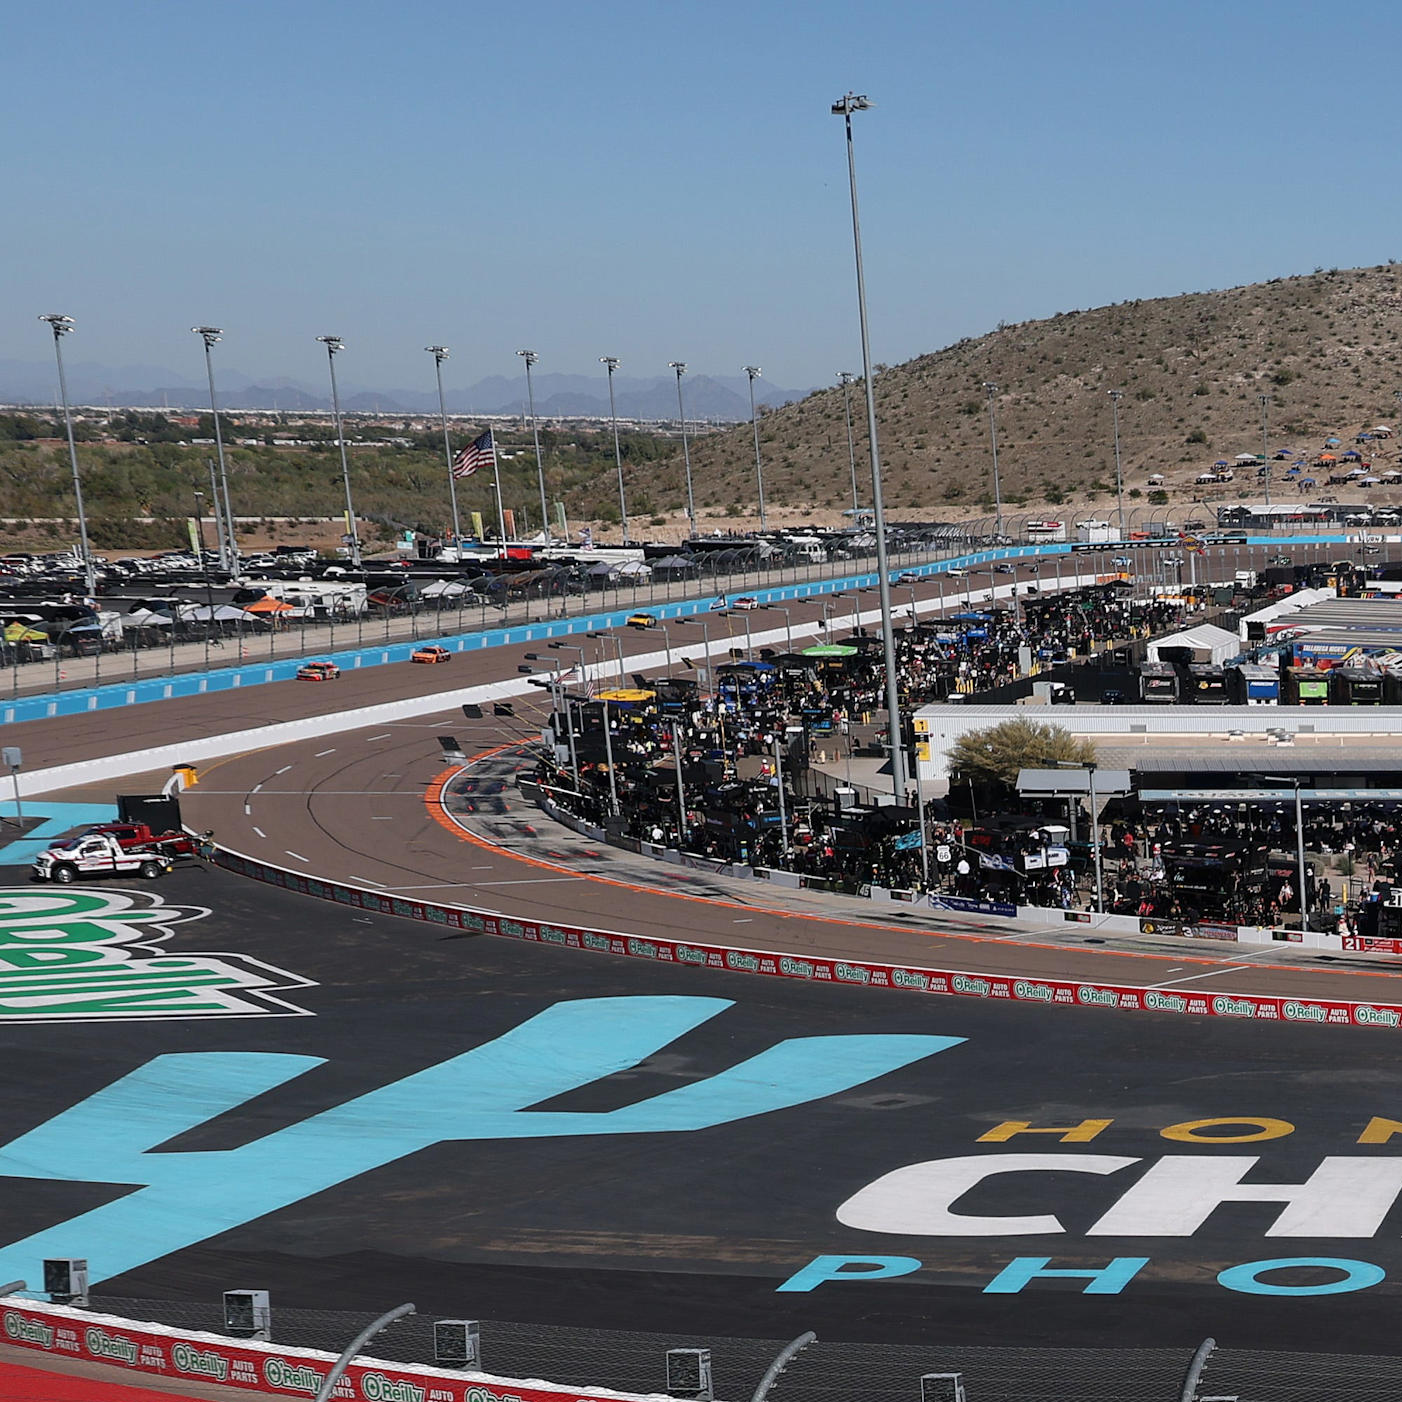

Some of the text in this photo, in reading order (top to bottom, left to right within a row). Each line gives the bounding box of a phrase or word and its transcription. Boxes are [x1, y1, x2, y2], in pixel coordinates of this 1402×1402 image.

[939, 850, 949, 861] 66
[1346, 938, 1360, 950] 21
[1213, 996, 1256, 1017] O'Reilly
[1259, 1004, 1276, 1012] AUTO
[1258, 1010, 1278, 1019] PARTS
[429, 1389, 454, 1402] AUTO
